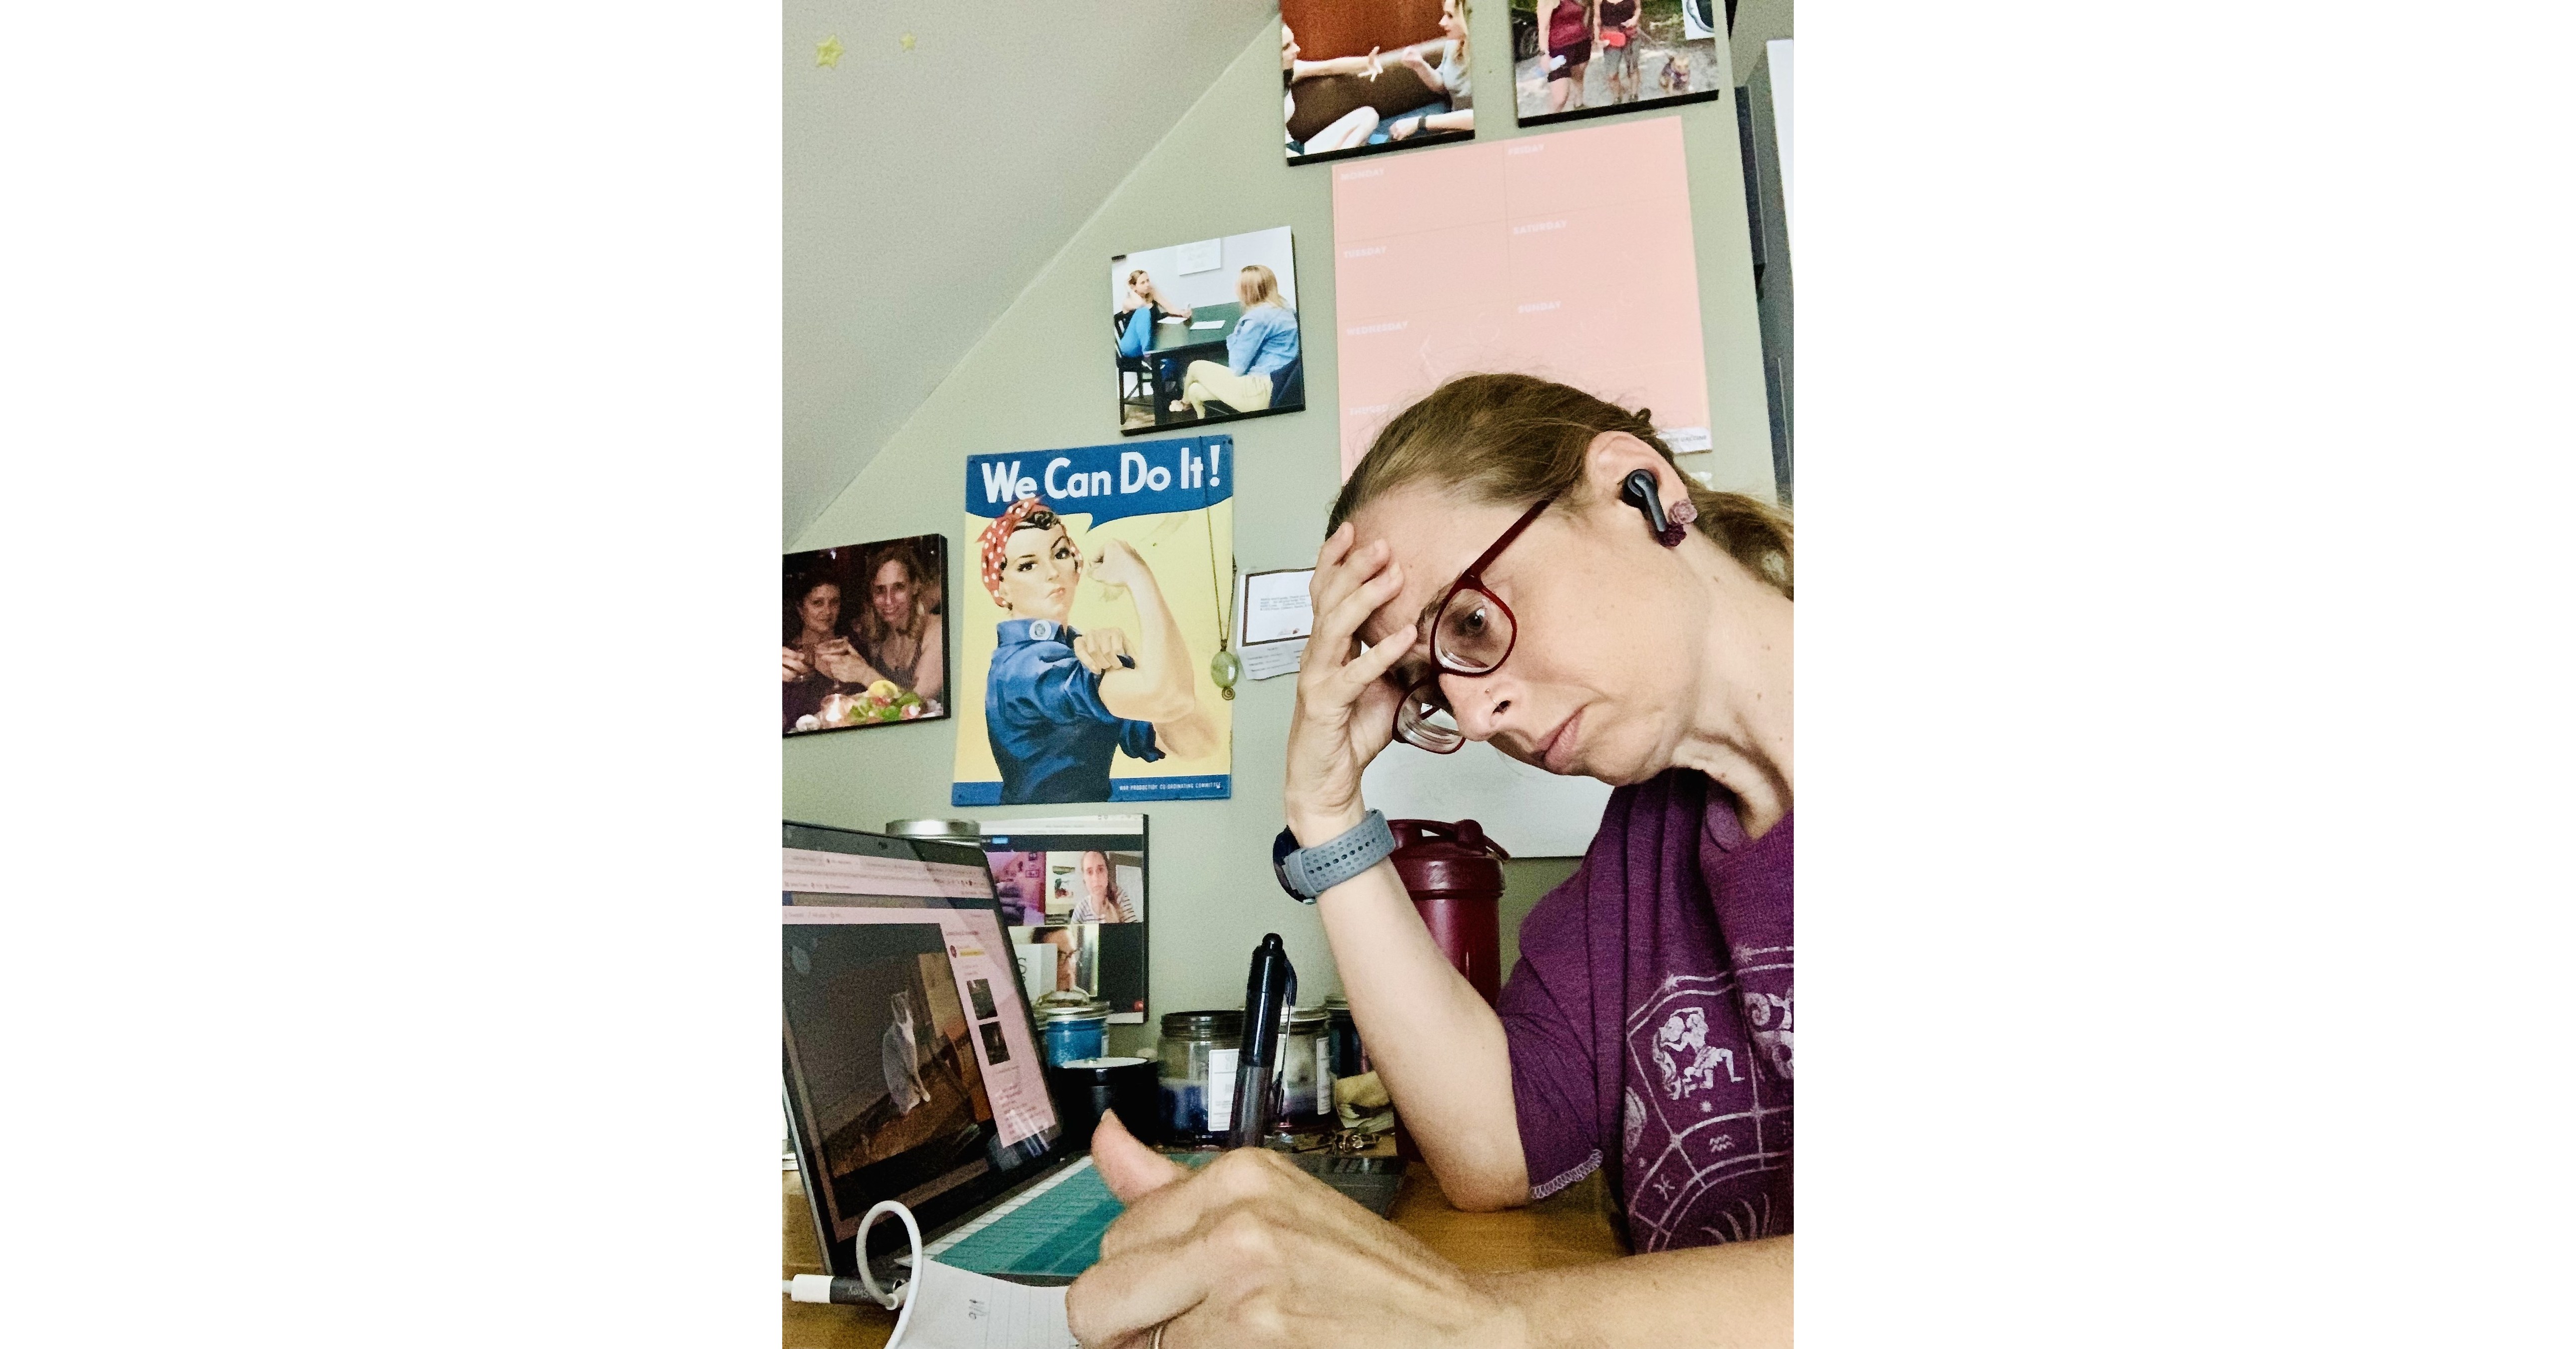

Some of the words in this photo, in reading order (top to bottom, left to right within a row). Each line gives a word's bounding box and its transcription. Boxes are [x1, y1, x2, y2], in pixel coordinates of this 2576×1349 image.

[1507, 143, 1545, 156] FRIDAY
[1340, 167, 1385, 181] MONDAY
[1513, 219, 1567, 235] SATURDAY
[1344, 246, 1387, 259] TUESDAY
[1518, 301, 1562, 314] SUNDAY
[1346, 320, 1409, 336] WEDNESDAY
[982, 460, 1038, 504] We
[1044, 457, 1112, 500] Can
[1120, 451, 1171, 494] Do
[1180, 445, 1220, 489] It!
